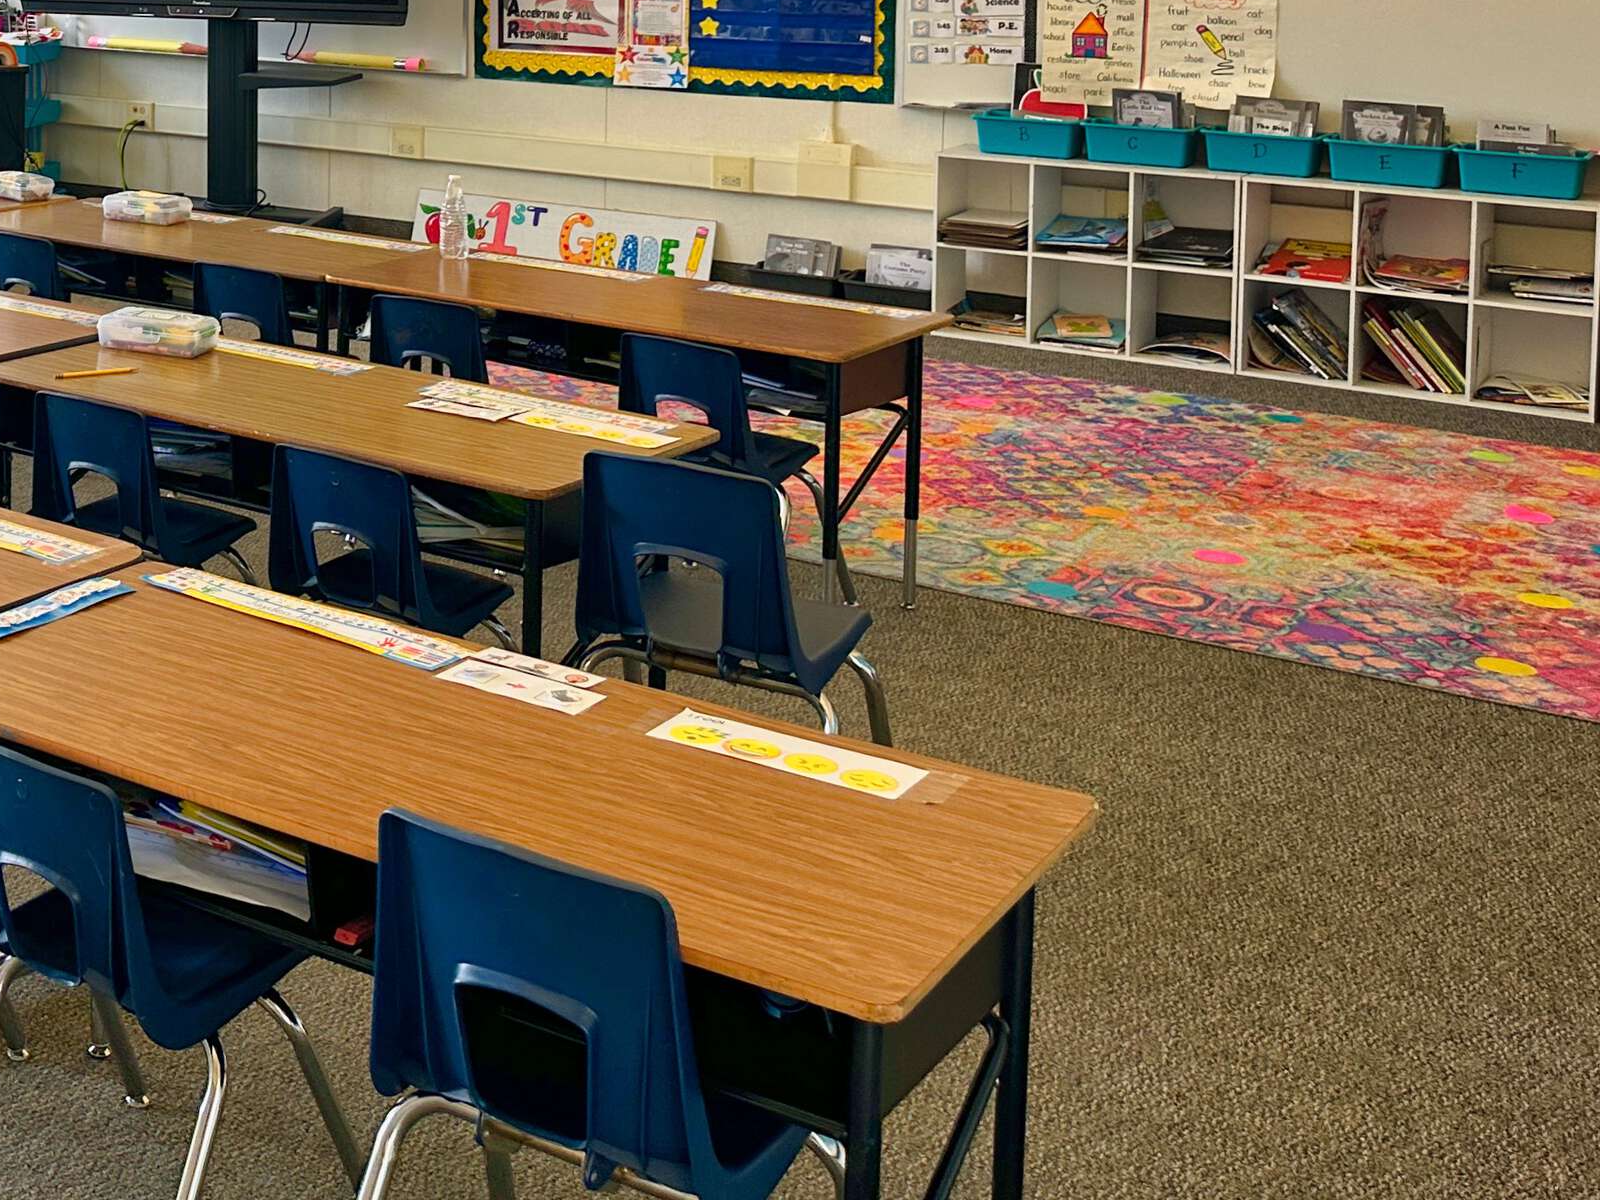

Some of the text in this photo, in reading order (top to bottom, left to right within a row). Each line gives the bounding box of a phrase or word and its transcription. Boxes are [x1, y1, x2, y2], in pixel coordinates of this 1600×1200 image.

[575, 11, 592, 20] ALL
[1167, 4, 1189, 16] fruit
[1247, 9, 1264, 19] cat
[507, 20, 569, 41] RESPONSIBLE
[998, 22, 1018, 30] P.E.
[1254, 26, 1273, 39] dog
[1221, 31, 1245, 43] pencil
[1159, 67, 1201, 79] Halloween
[1127, 136, 1139, 150] C
[1252, 143, 1268, 159] D
[1379, 154, 1392, 170] E
[1512, 162, 1528, 179] F
[478, 201, 680, 277] 1ST GRADE
